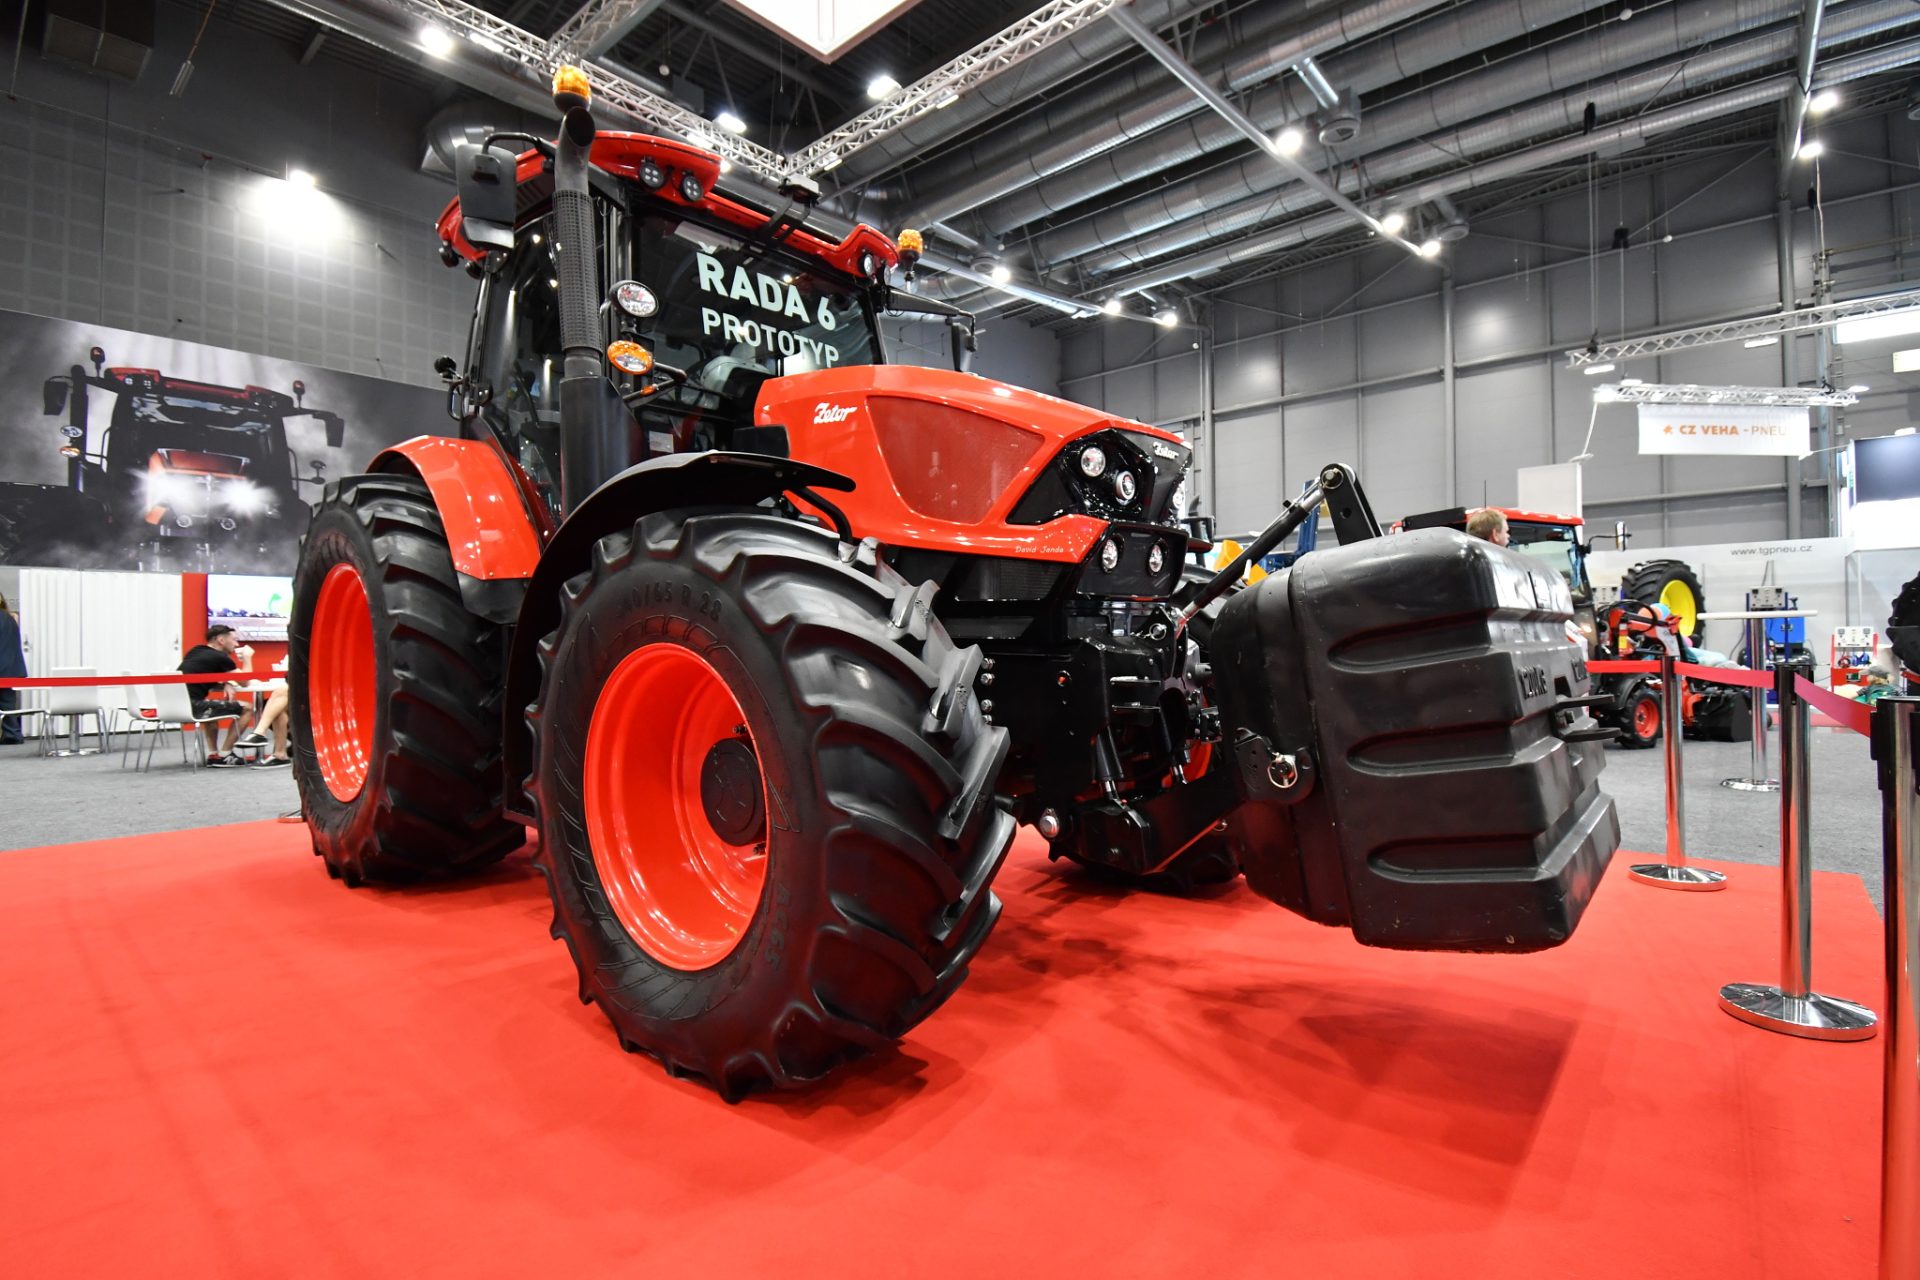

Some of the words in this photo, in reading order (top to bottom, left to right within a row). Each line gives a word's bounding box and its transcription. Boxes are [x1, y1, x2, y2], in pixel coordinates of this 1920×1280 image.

[817, 296, 836, 331] 6
[701, 306, 840, 369] PROTOTYP
[813, 402, 859, 425] Zetor
[1678, 424, 1697, 436] CZ
[1700, 424, 1740, 436] VEHA
[1015, 545, 1037, 553] David
[1730, 545, 1813, 556] www.tgpneu.cz
